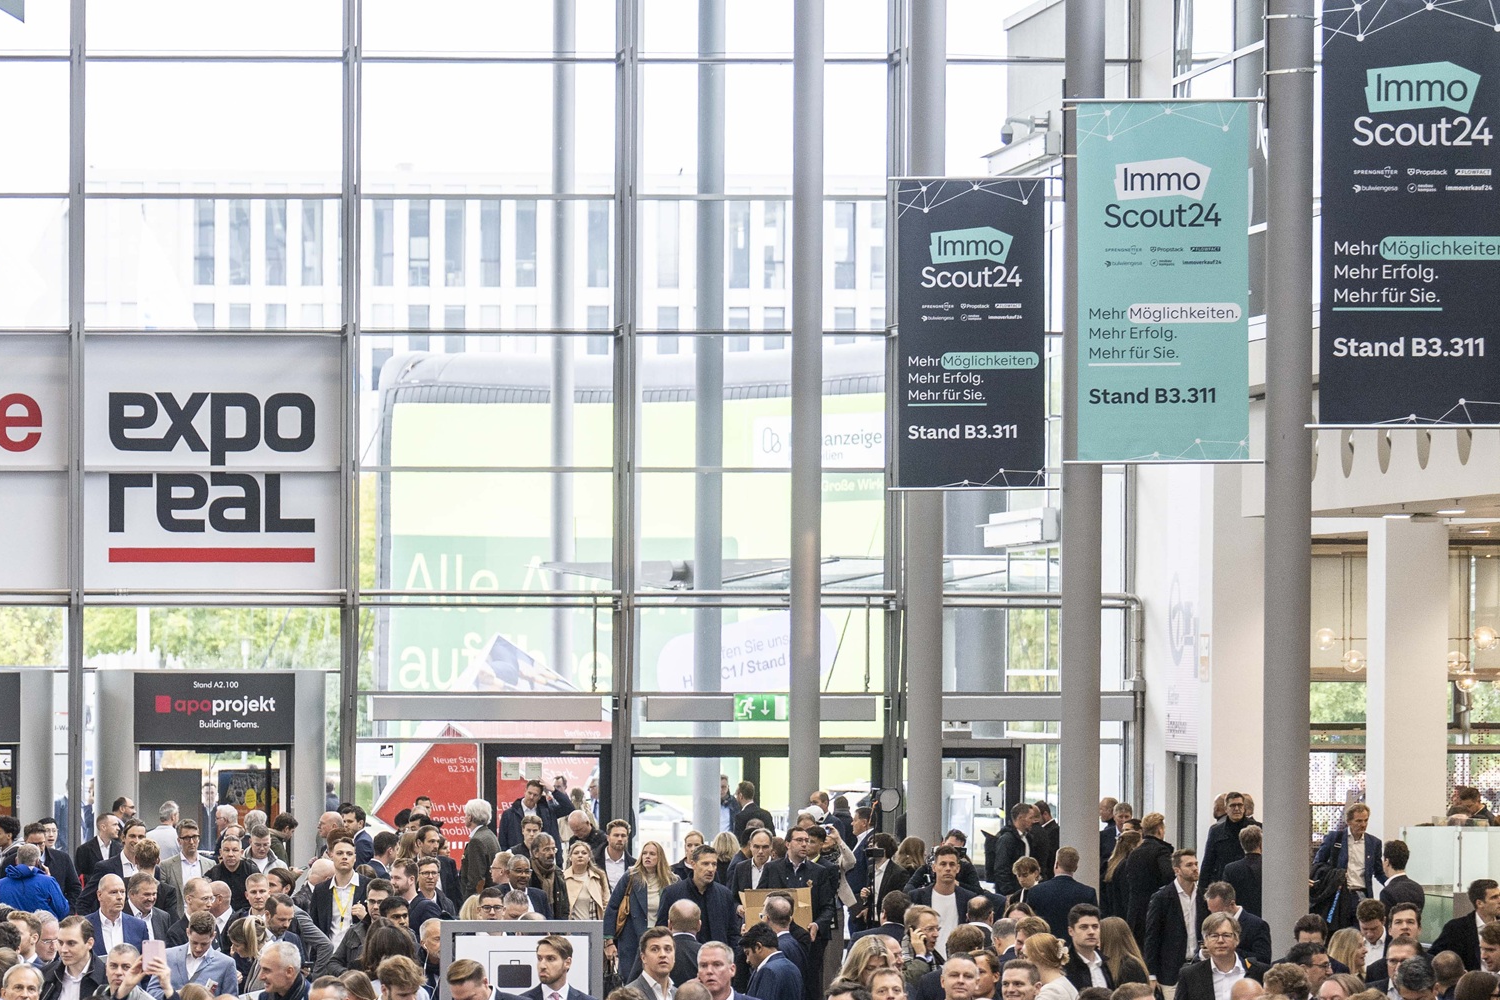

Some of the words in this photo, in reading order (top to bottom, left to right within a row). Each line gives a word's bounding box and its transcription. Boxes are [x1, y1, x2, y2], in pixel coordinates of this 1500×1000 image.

[1376, 73, 1468, 102] Immo
[1352, 116, 1493, 147] Scout24
[1123, 167, 1201, 191] Immo
[1104, 202, 1222, 228] Scout24
[937, 235, 1004, 256] Immo
[1334, 241, 1378, 255] Mehr
[921, 266, 1023, 288] Scout24
[1334, 264, 1378, 279] Mehr
[1382, 264, 1439, 282] Erfolg.
[1334, 288, 1378, 303] Mehr
[1381, 288, 1406, 303] für
[1410, 288, 1441, 303] Sie.
[1089, 307, 1126, 320] Mehr
[1129, 306, 1238, 322] Möglichkeiten.
[1089, 327, 1126, 339] Mehr
[1129, 326, 1177, 341] Erfolg.
[1089, 347, 1126, 359] Mehr
[1129, 346, 1150, 359] für
[1153, 346, 1179, 359] Sie.
[1333, 336, 1405, 357] Stand
[1411, 337, 1485, 357] B3.311
[908, 356, 940, 367] Mehr
[943, 355, 1037, 369] Möglichkeiten.
[908, 373, 940, 384] Mehr
[943, 372, 984, 386] Erfolg.
[908, 389, 940, 400] Mehr
[942, 389, 961, 400] für
[963, 389, 986, 400] Sie.
[1088, 387, 1149, 404] Stand
[1155, 387, 1216, 404] B3.311
[108, 392, 316, 467] expo
[908, 424, 960, 439] Stand
[964, 424, 1018, 439] B3.311
[747, 653, 787, 675] Stand
[174, 695, 276, 716] apoprojekt
[199, 719, 232, 730] Building
[232, 719, 260, 729] Teams.
[433, 756, 457, 764] Neuer
[447, 764, 475, 773] B2.314
